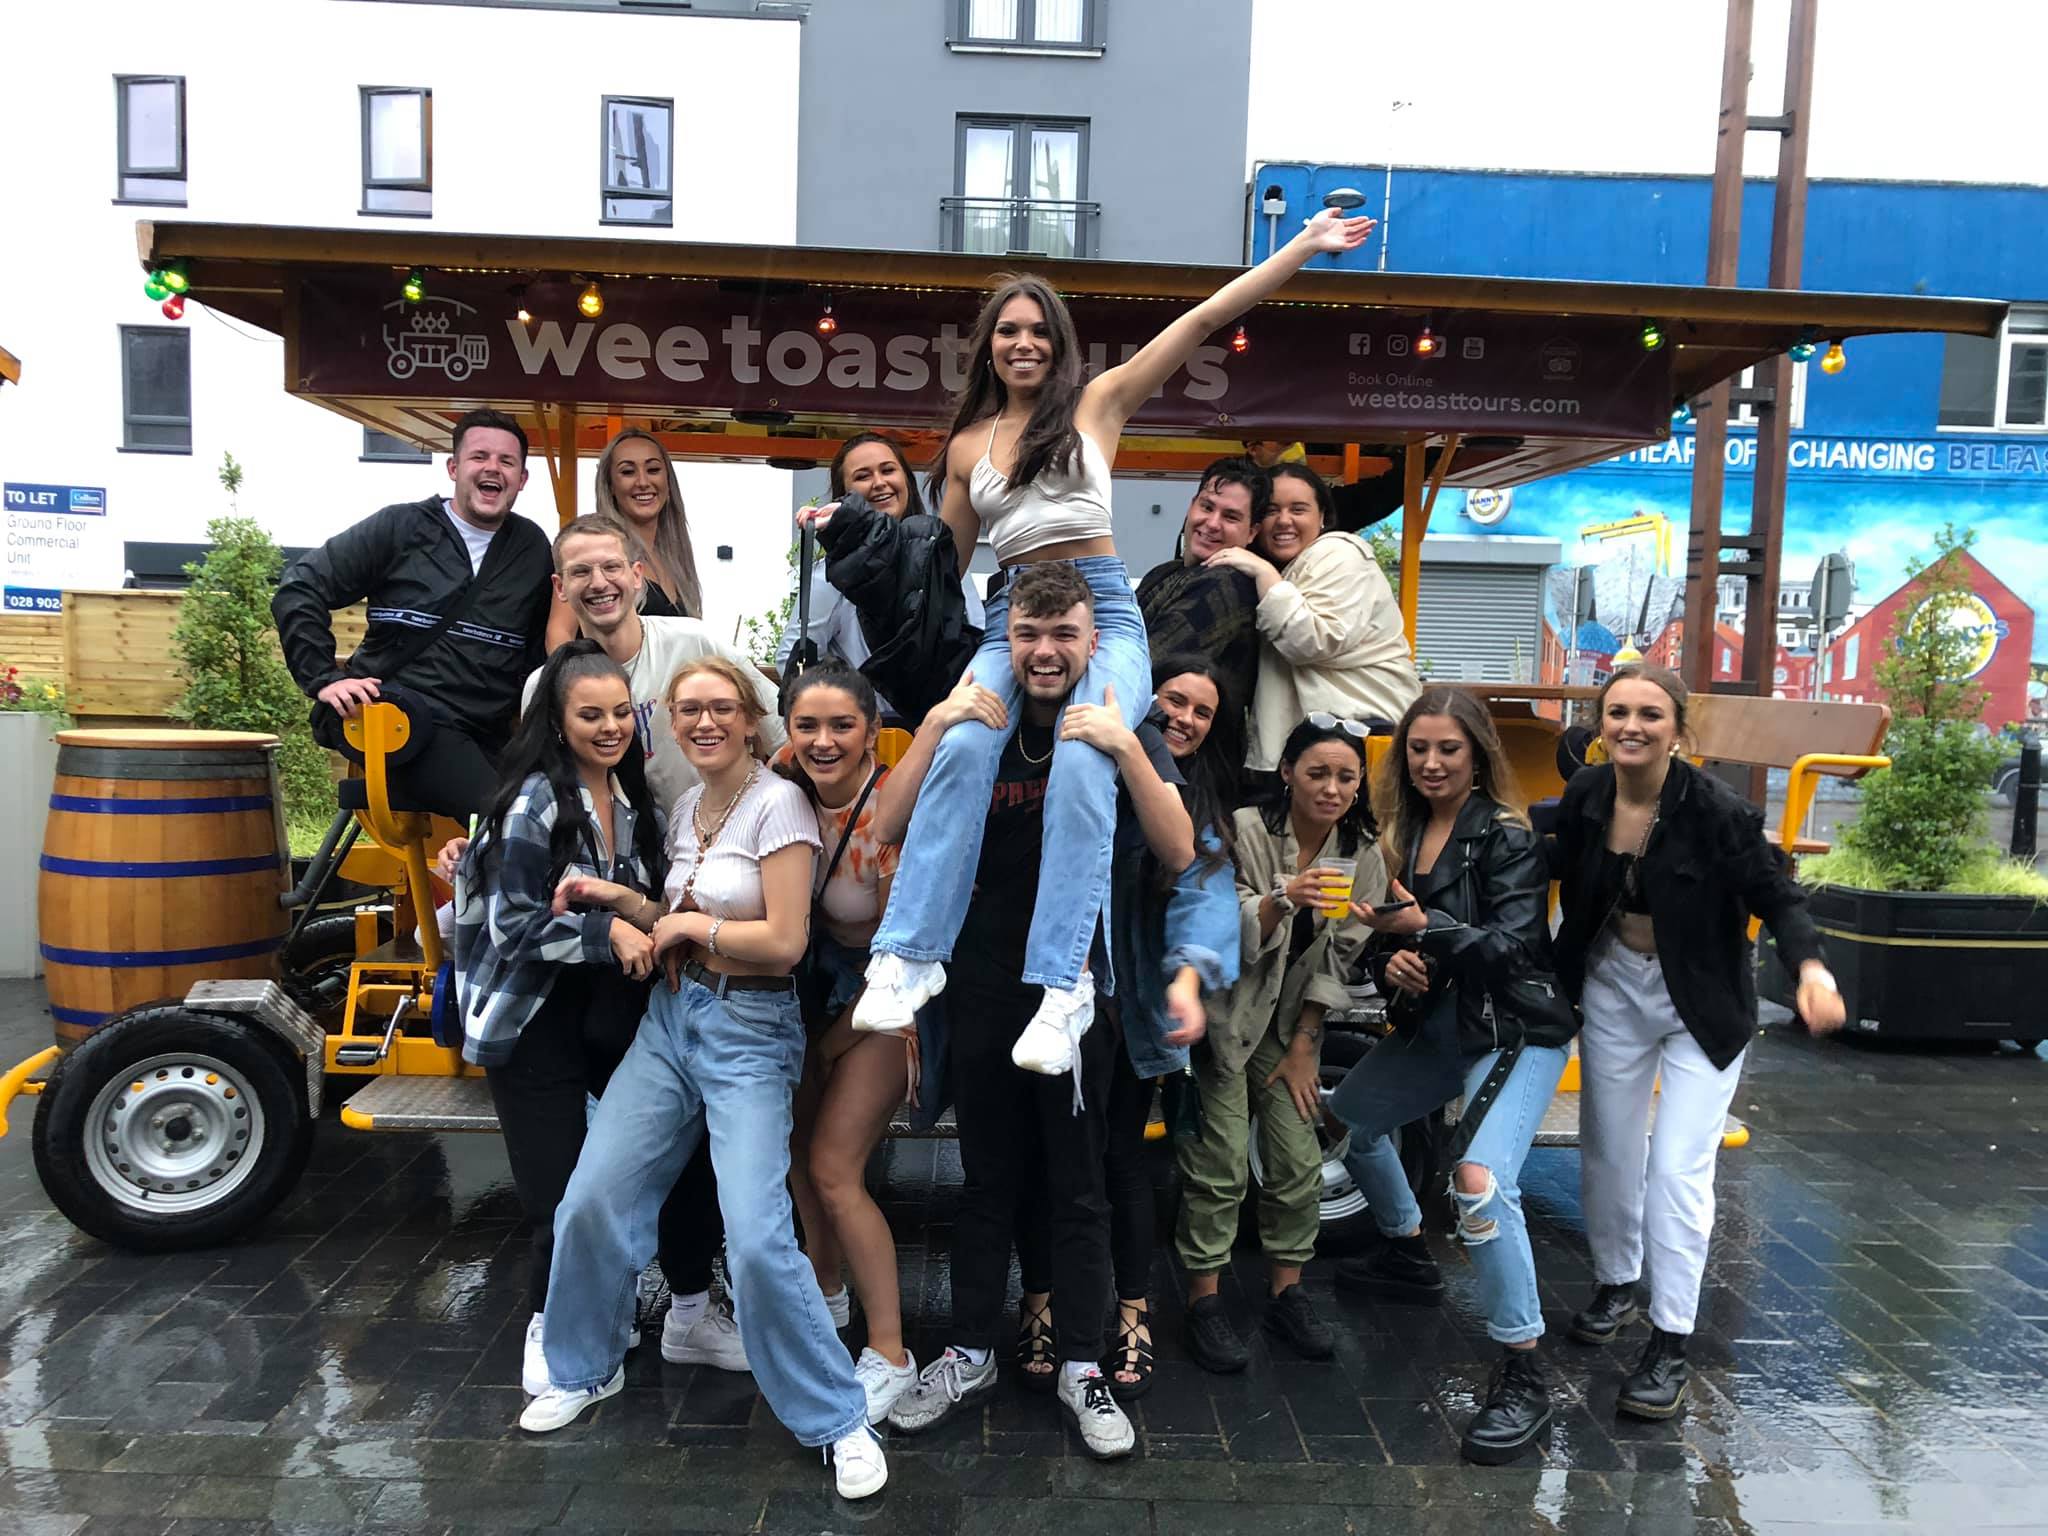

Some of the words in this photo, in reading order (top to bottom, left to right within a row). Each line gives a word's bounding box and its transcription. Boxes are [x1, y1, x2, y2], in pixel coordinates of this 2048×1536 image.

[505, 317, 709, 382] wee
[722, 314, 970, 393] toast
[1348, 371, 1381, 385] Book
[1385, 372, 1433, 387] Online
[1347, 391, 1580, 414] weetoasttours.com
[1789, 440, 1935, 471] CHANGING
[6, 490, 26, 504] TO
[29, 491, 58, 505] LET
[7, 514, 52, 530] Ground
[56, 516, 88, 532] Floor
[7, 532, 80, 549] Commercial
[7, 551, 31, 565] Unit
[10, 595, 34, 608] 028
